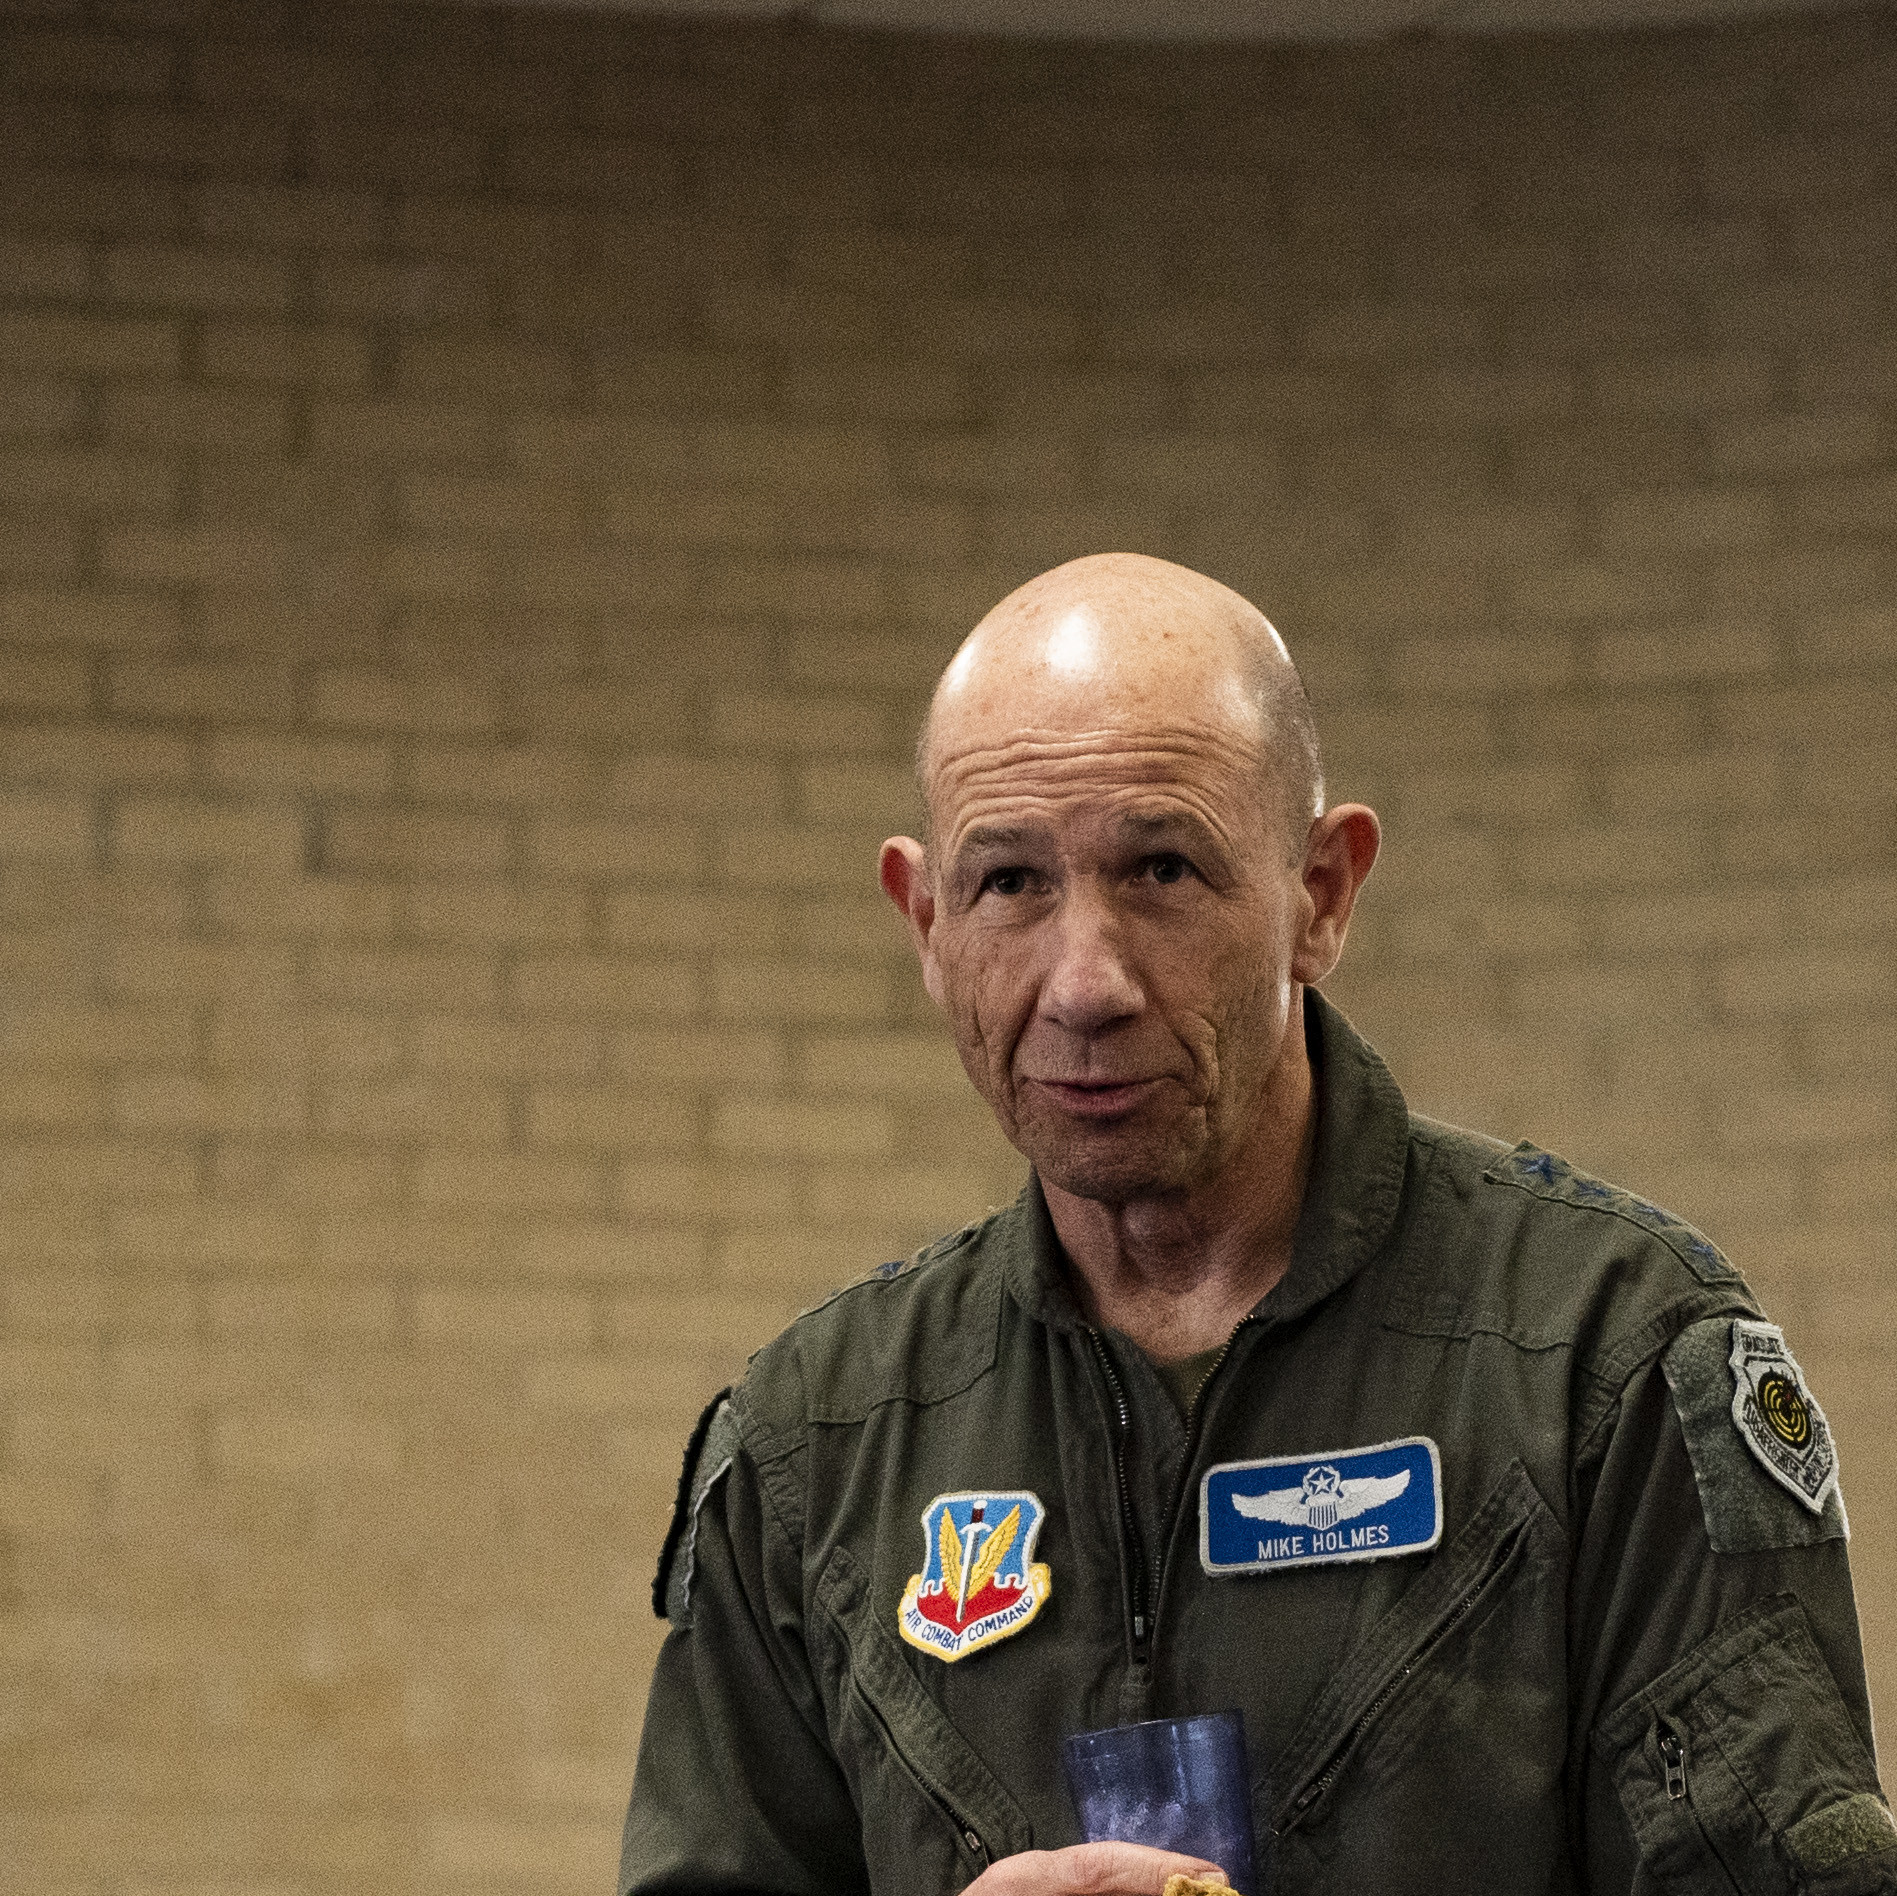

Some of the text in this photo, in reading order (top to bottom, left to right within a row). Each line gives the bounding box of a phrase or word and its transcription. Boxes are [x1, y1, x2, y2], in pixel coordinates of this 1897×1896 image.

[1257, 1525, 1390, 1560] MIKE HOLMES
[905, 1595, 1035, 1652] AIR COMBAT COMMAND
